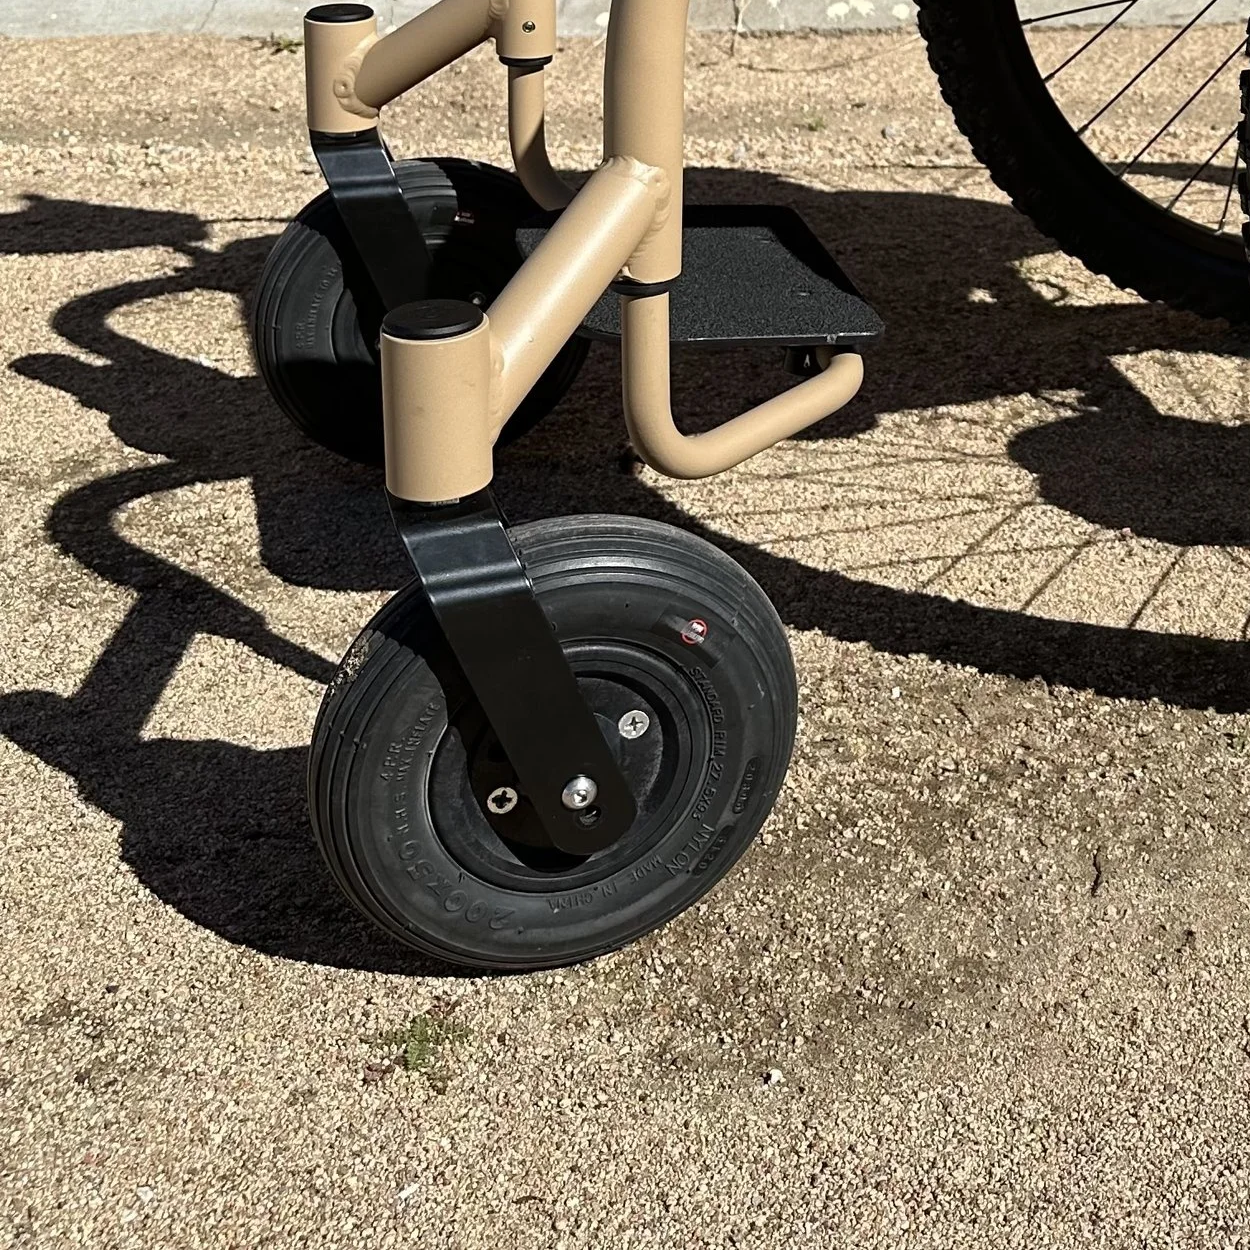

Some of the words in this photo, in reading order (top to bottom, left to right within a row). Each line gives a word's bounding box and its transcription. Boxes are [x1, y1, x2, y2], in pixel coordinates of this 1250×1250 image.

[688, 666, 724, 724] STANDARD
[713, 729, 728, 756] RIM
[629, 853, 664, 884] MADE
[665, 823, 715, 877] NYLON
[547, 892, 594, 914] CHINA
